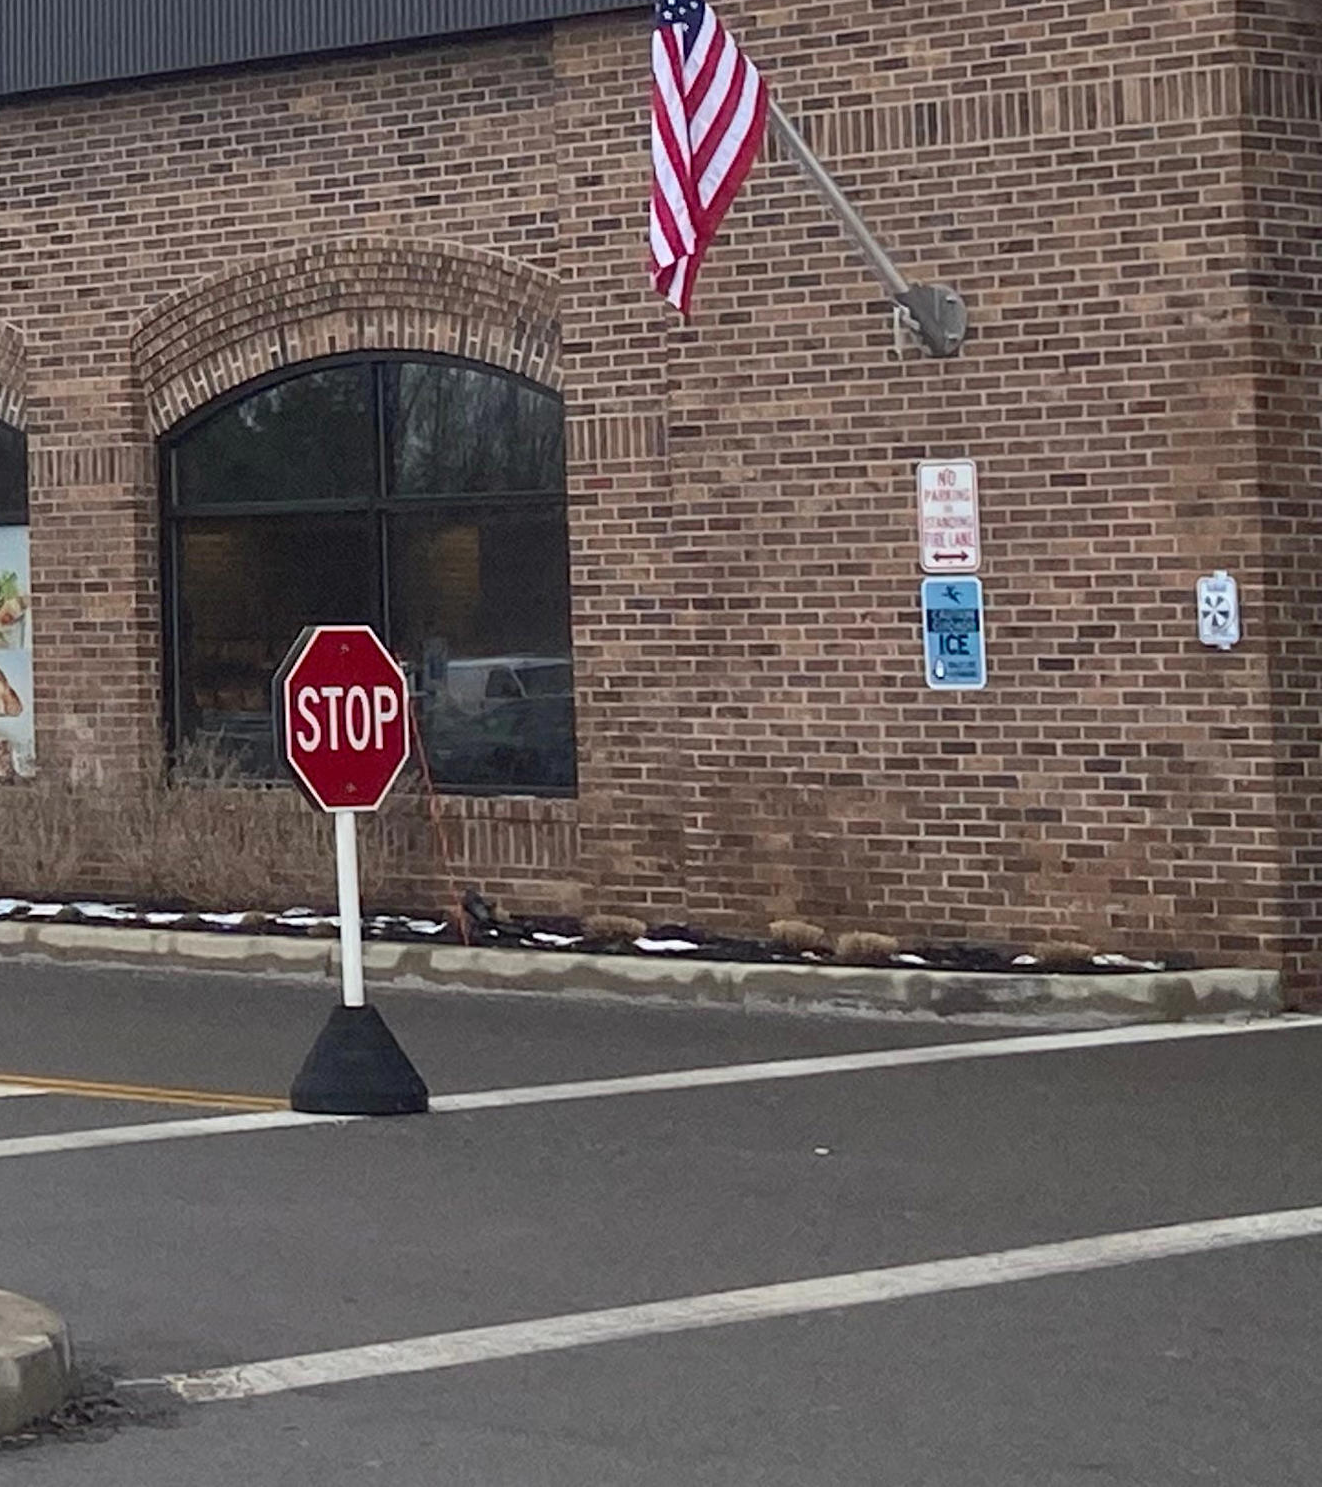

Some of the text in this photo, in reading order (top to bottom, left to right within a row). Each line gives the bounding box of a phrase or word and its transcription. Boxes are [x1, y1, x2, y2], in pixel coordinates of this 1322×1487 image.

[938, 468, 956, 486] NO
[939, 634, 970, 655] ICE
[296, 686, 399, 753] STOP
